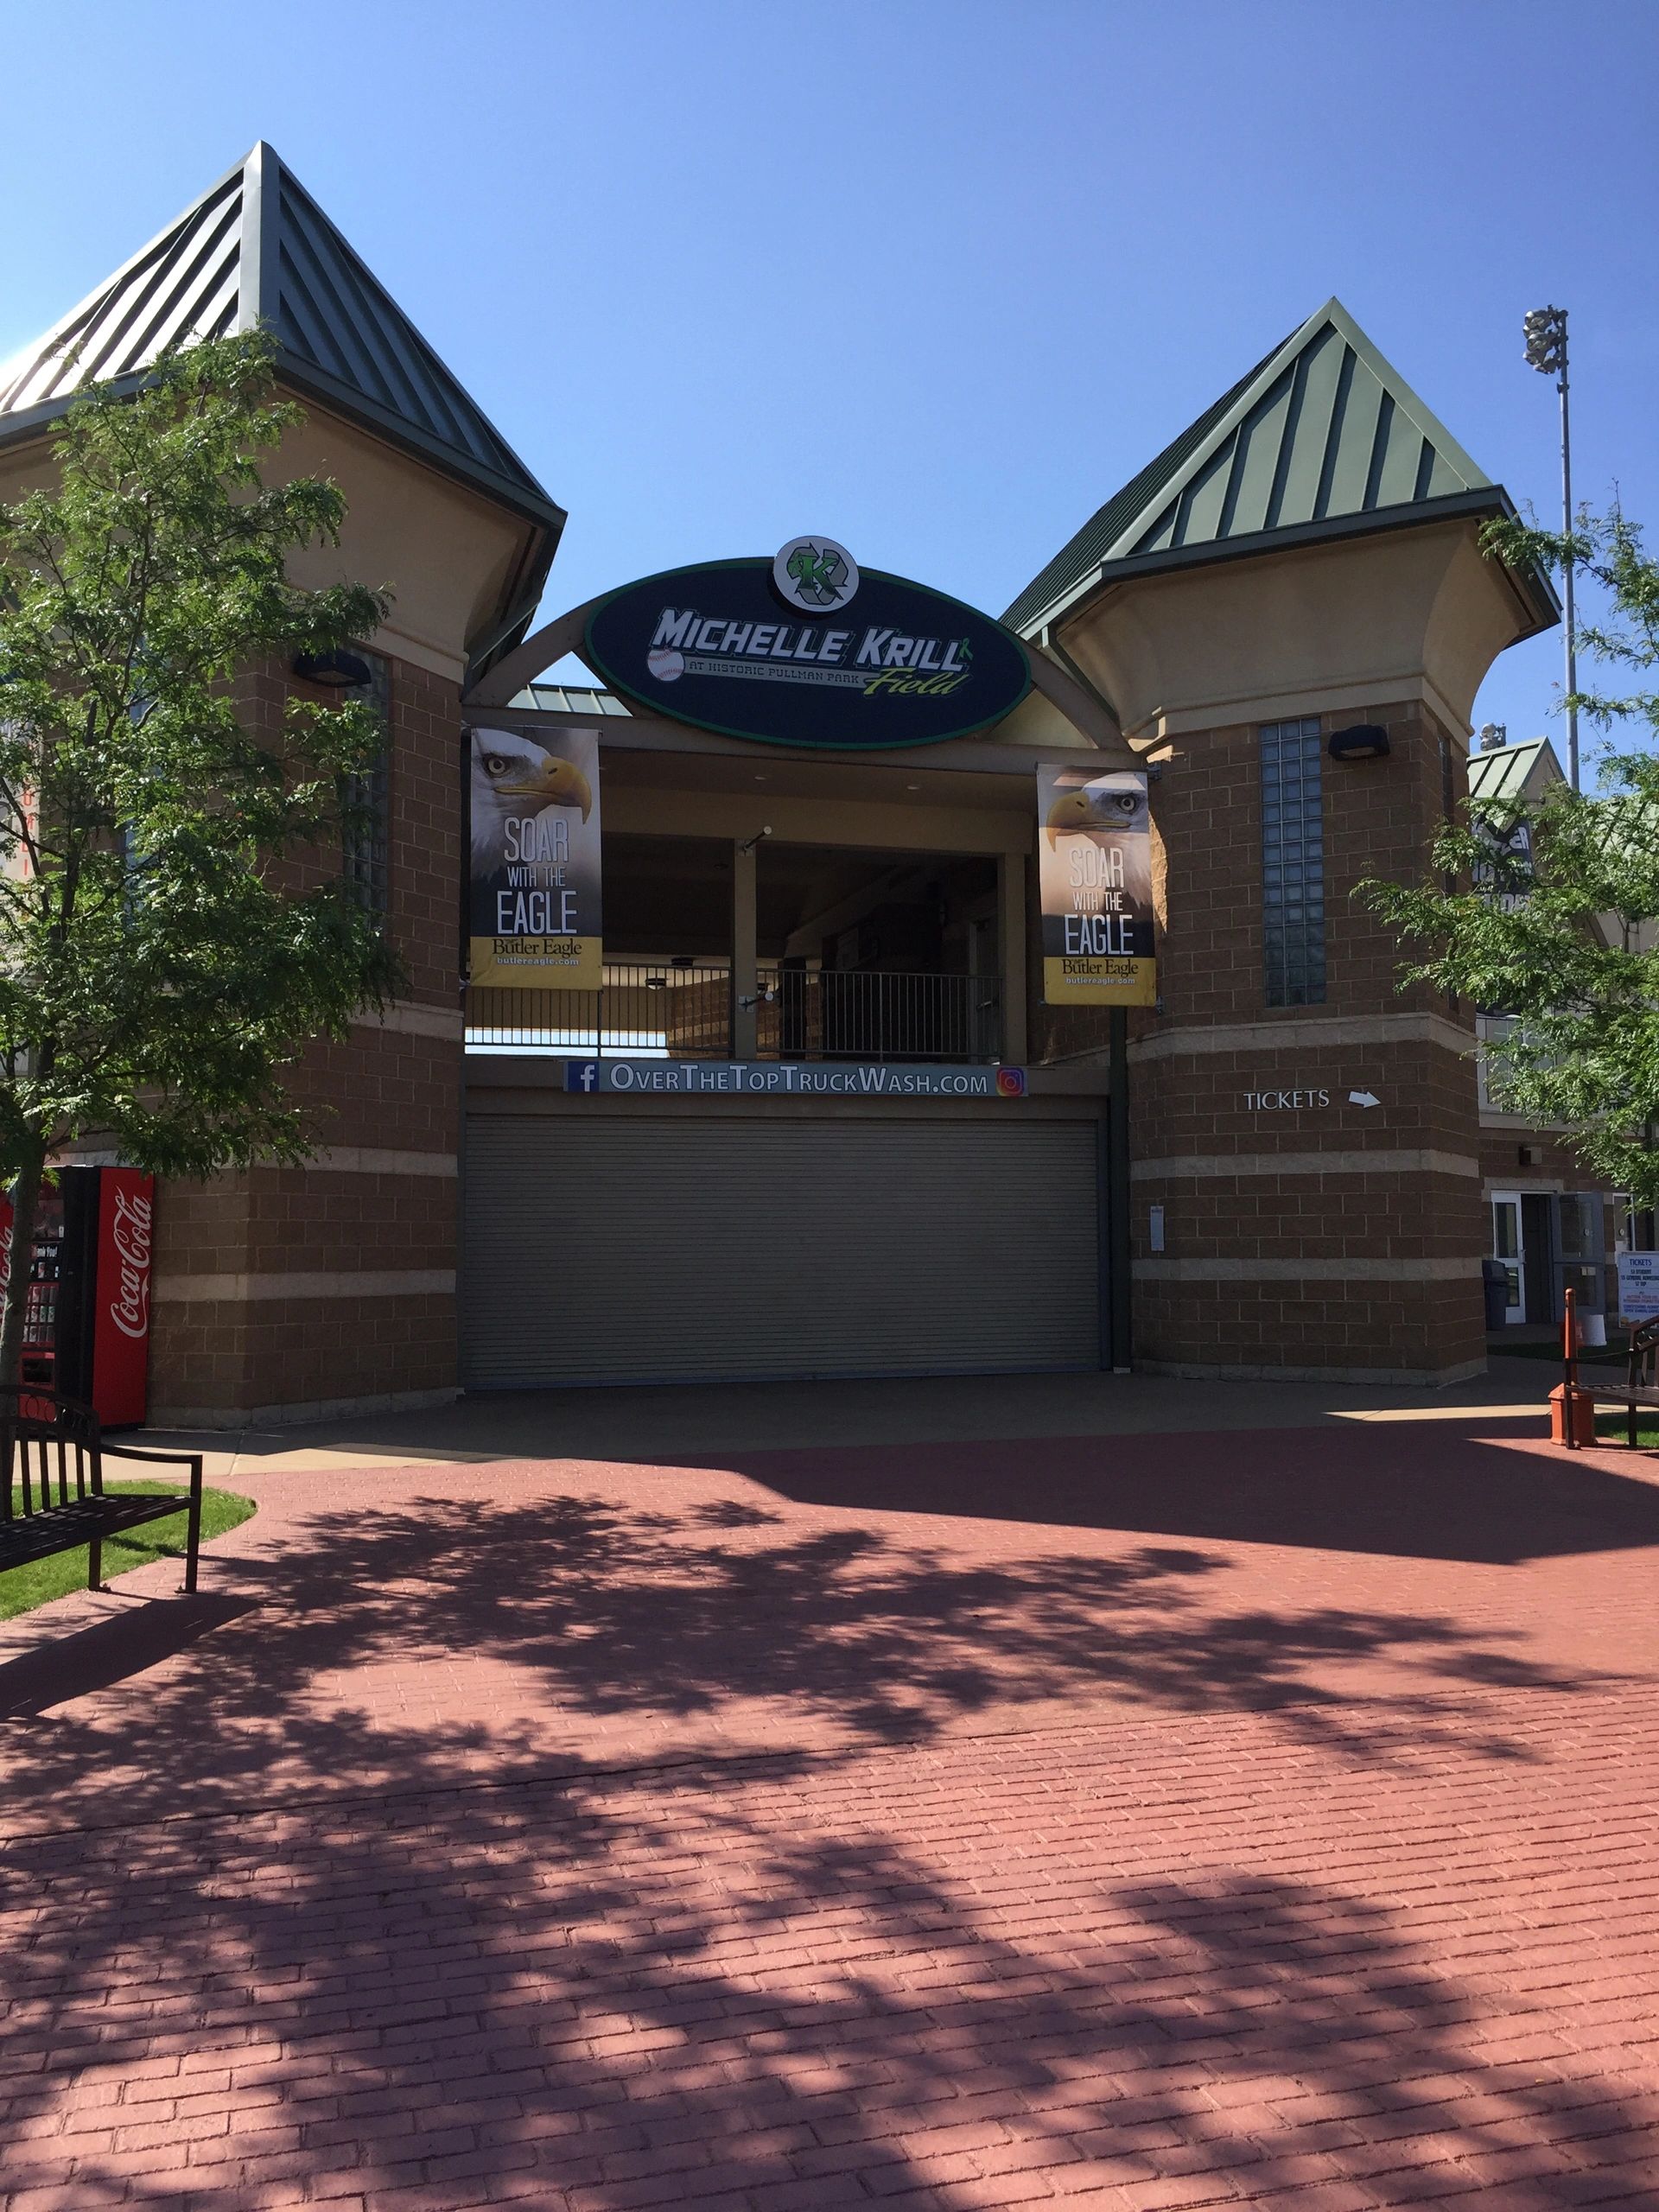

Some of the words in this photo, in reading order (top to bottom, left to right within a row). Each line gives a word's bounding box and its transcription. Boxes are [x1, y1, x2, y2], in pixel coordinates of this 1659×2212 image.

[689, 660, 705, 671] AT
[709, 663, 765, 676] HISTORIC
[768, 668, 823, 681] PULLMAN
[827, 673, 860, 684] PARK
[863, 667, 969, 695] Field
[504, 817, 569, 862] SOAR
[507, 866, 537, 887] WITH
[543, 866, 566, 887] THE
[1069, 847, 1124, 888] SOAR
[497, 890, 578, 934] EAGLE
[1072, 891, 1098, 912] WITH
[1103, 891, 1123, 912] THE
[1064, 913, 1135, 956] EAGLE
[492, 938, 539, 955] Butler
[543, 938, 582, 958] Eagle
[497, 957, 580, 966] butlereagle.com
[1062, 958, 1103, 975] Butler
[1104, 958, 1139, 978] Eagle
[1243, 1089, 1330, 1110] TICKETS
